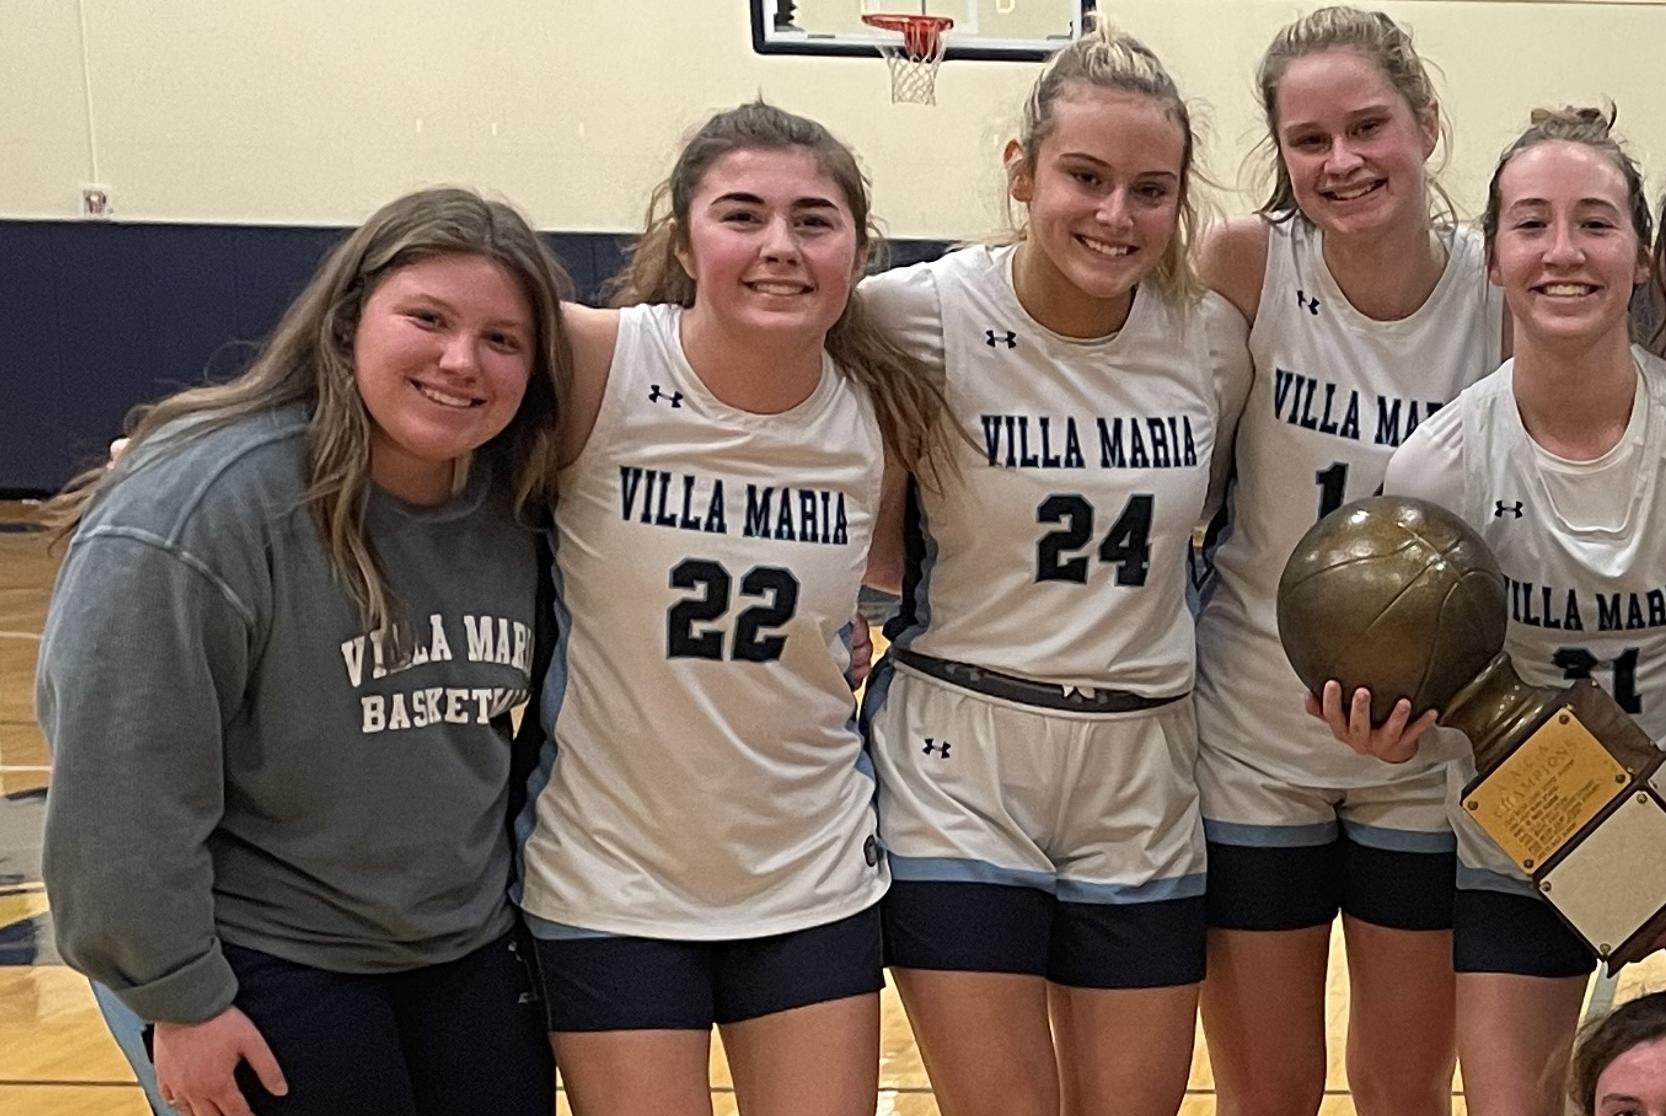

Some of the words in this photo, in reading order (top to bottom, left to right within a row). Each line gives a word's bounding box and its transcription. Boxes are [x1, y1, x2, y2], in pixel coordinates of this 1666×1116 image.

[1274, 368, 1360, 440] VILLA
[980, 414, 1085, 469] VILLA
[1097, 415, 1197, 469] MARIA
[619, 464, 728, 535] VILLA
[743, 483, 848, 545] MARIA
[1034, 493, 1155, 587] 24
[665, 557, 801, 662] 22
[1504, 574, 1584, 631] ILLA
[341, 614, 453, 688] VILA
